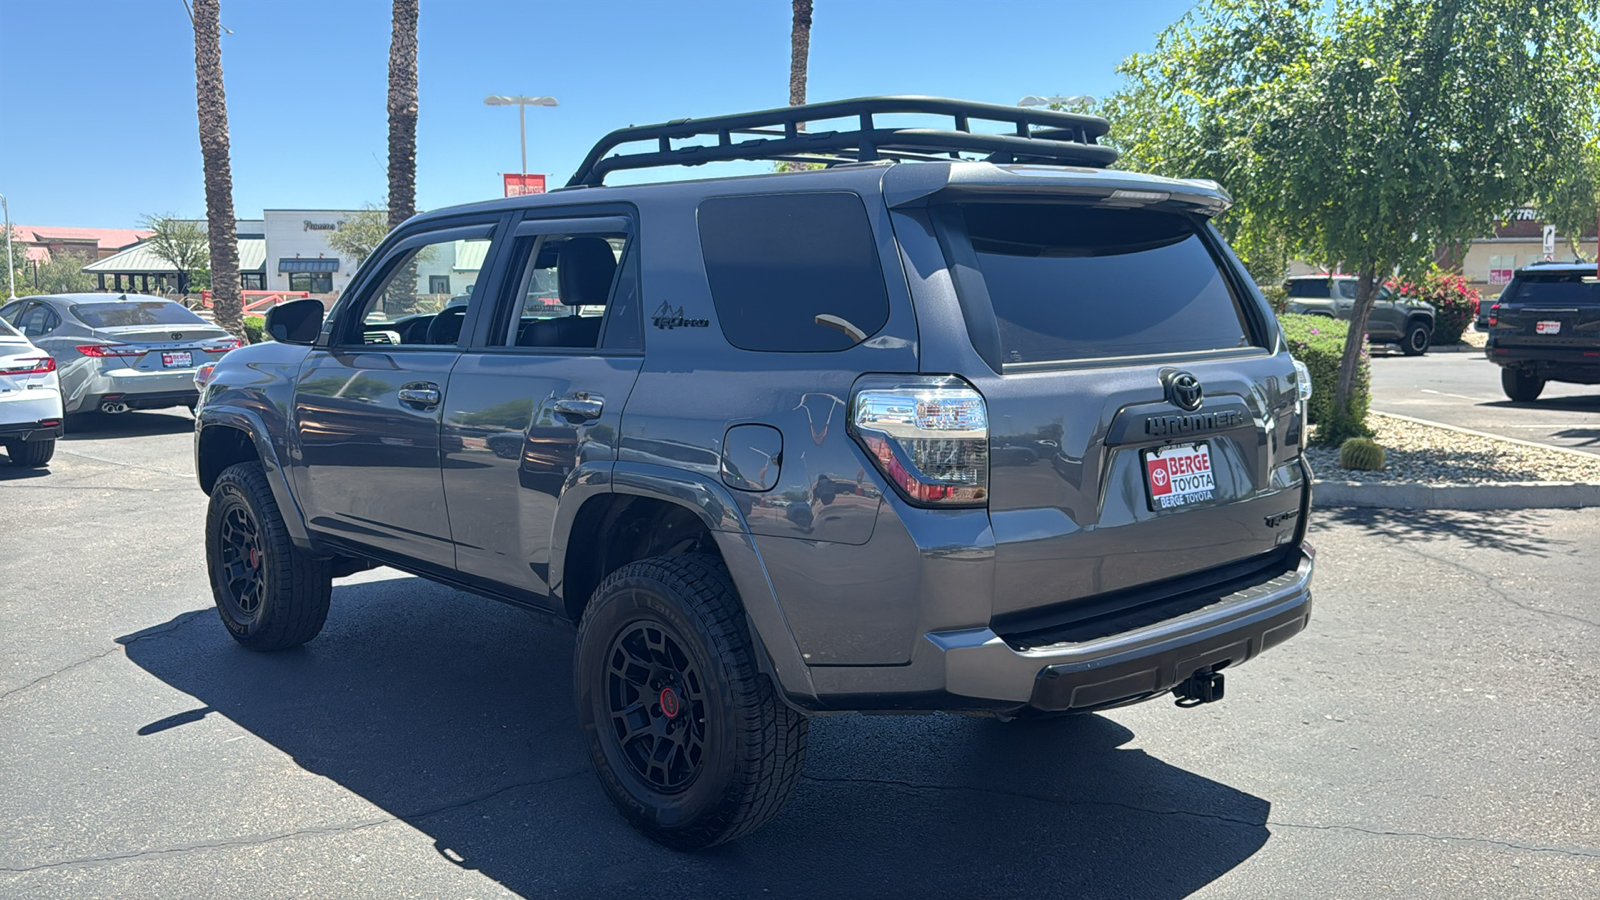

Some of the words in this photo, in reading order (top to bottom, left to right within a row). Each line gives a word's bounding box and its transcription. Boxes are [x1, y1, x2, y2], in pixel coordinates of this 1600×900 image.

[1169, 453, 1210, 476] BERGE
[1171, 473, 1214, 492] TOYOTA
[1160, 495, 1185, 509] BERGE
[1185, 490, 1213, 504] TOYOTA
